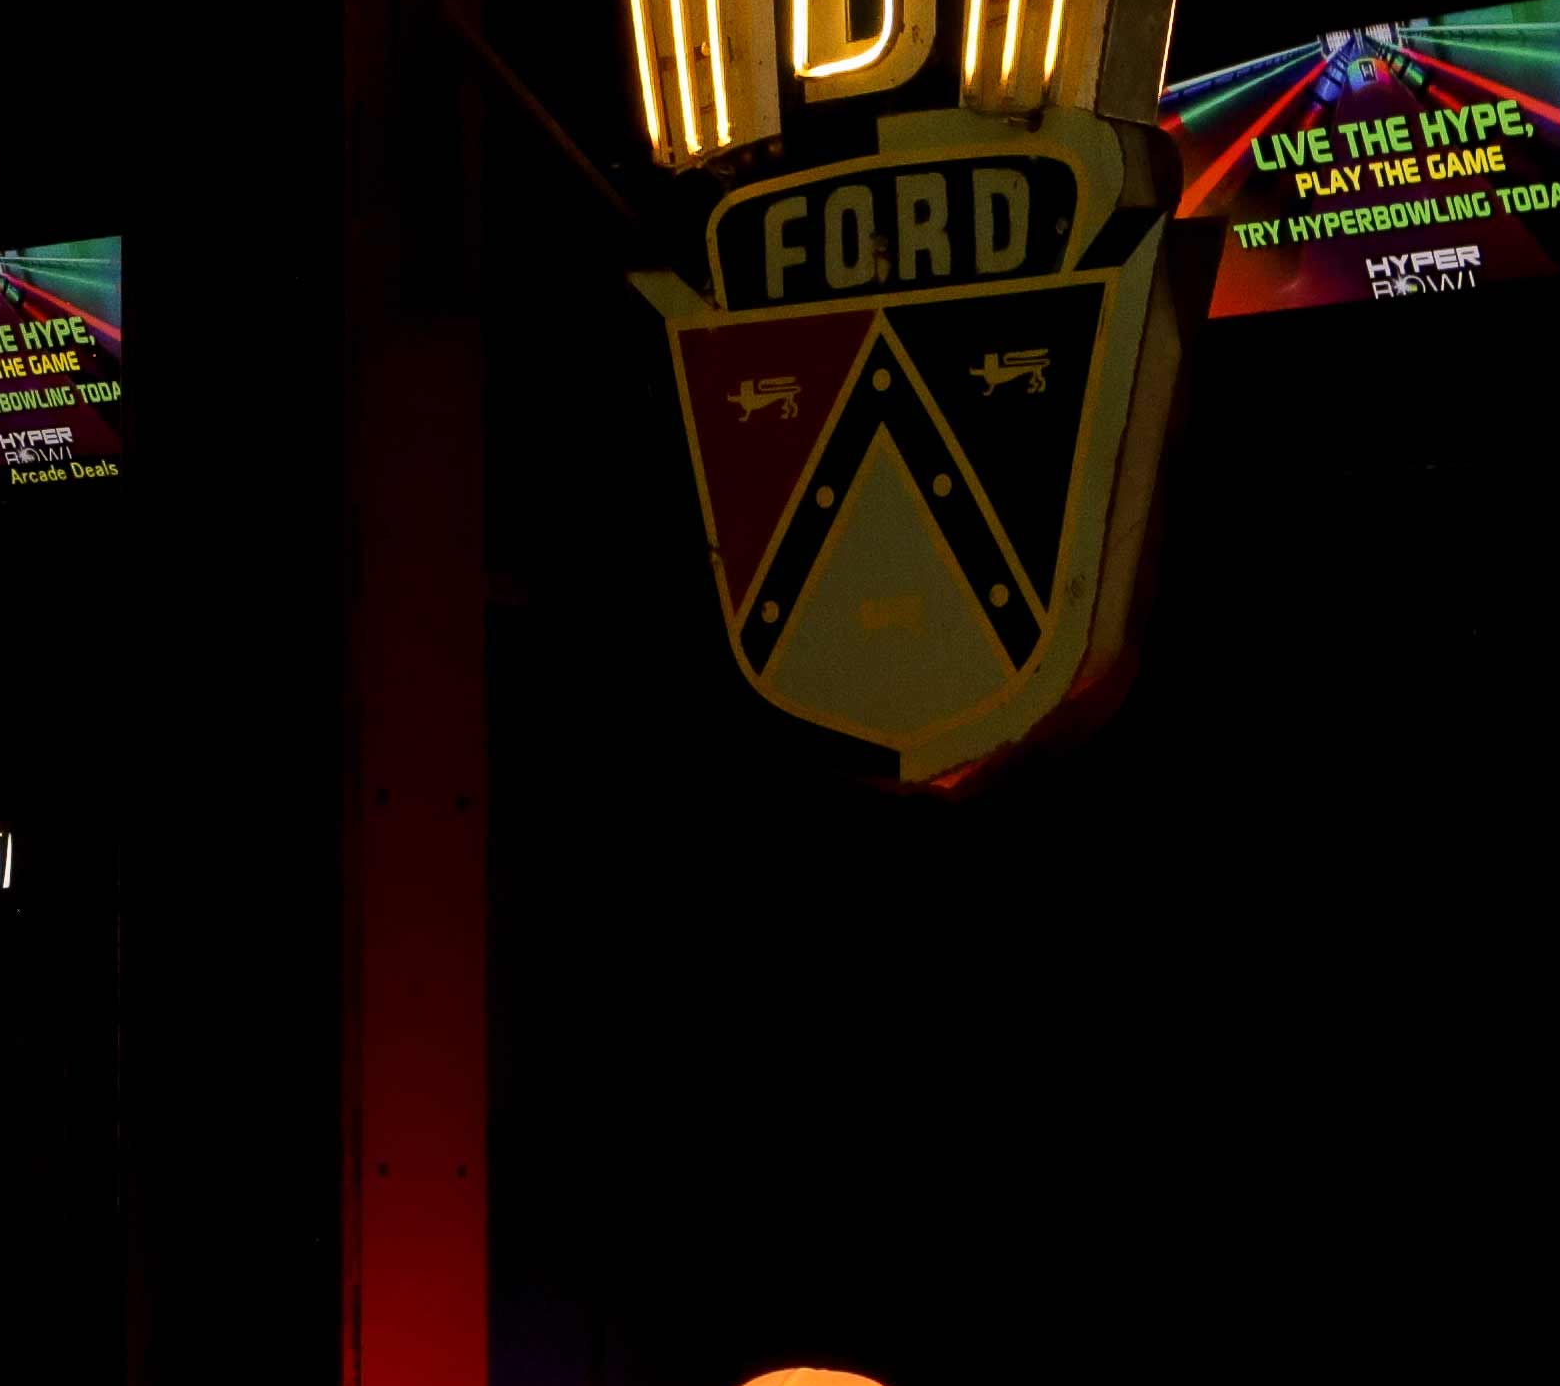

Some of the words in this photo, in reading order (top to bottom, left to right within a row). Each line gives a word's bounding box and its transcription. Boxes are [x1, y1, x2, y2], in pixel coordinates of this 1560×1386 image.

[1251, 128, 1333, 171] LIVE
[1338, 116, 1414, 158] THE
[1418, 100, 1534, 148] HYPE,
[1295, 165, 1362, 198] PLAY
[1369, 158, 1422, 188] THE
[1426, 145, 1506, 180] GAME
[763, 167, 1030, 300] FORD
[1233, 220, 1281, 248] TRY
[1287, 190, 1491, 243] HYPERBOWLING
[1365, 245, 1481, 279] HYPER
[19, 316, 96, 350] HYPE,
[28, 351, 81, 375] GAME
[11, 464, 67, 485] Arcade
[70, 459, 119, 479] Deals
